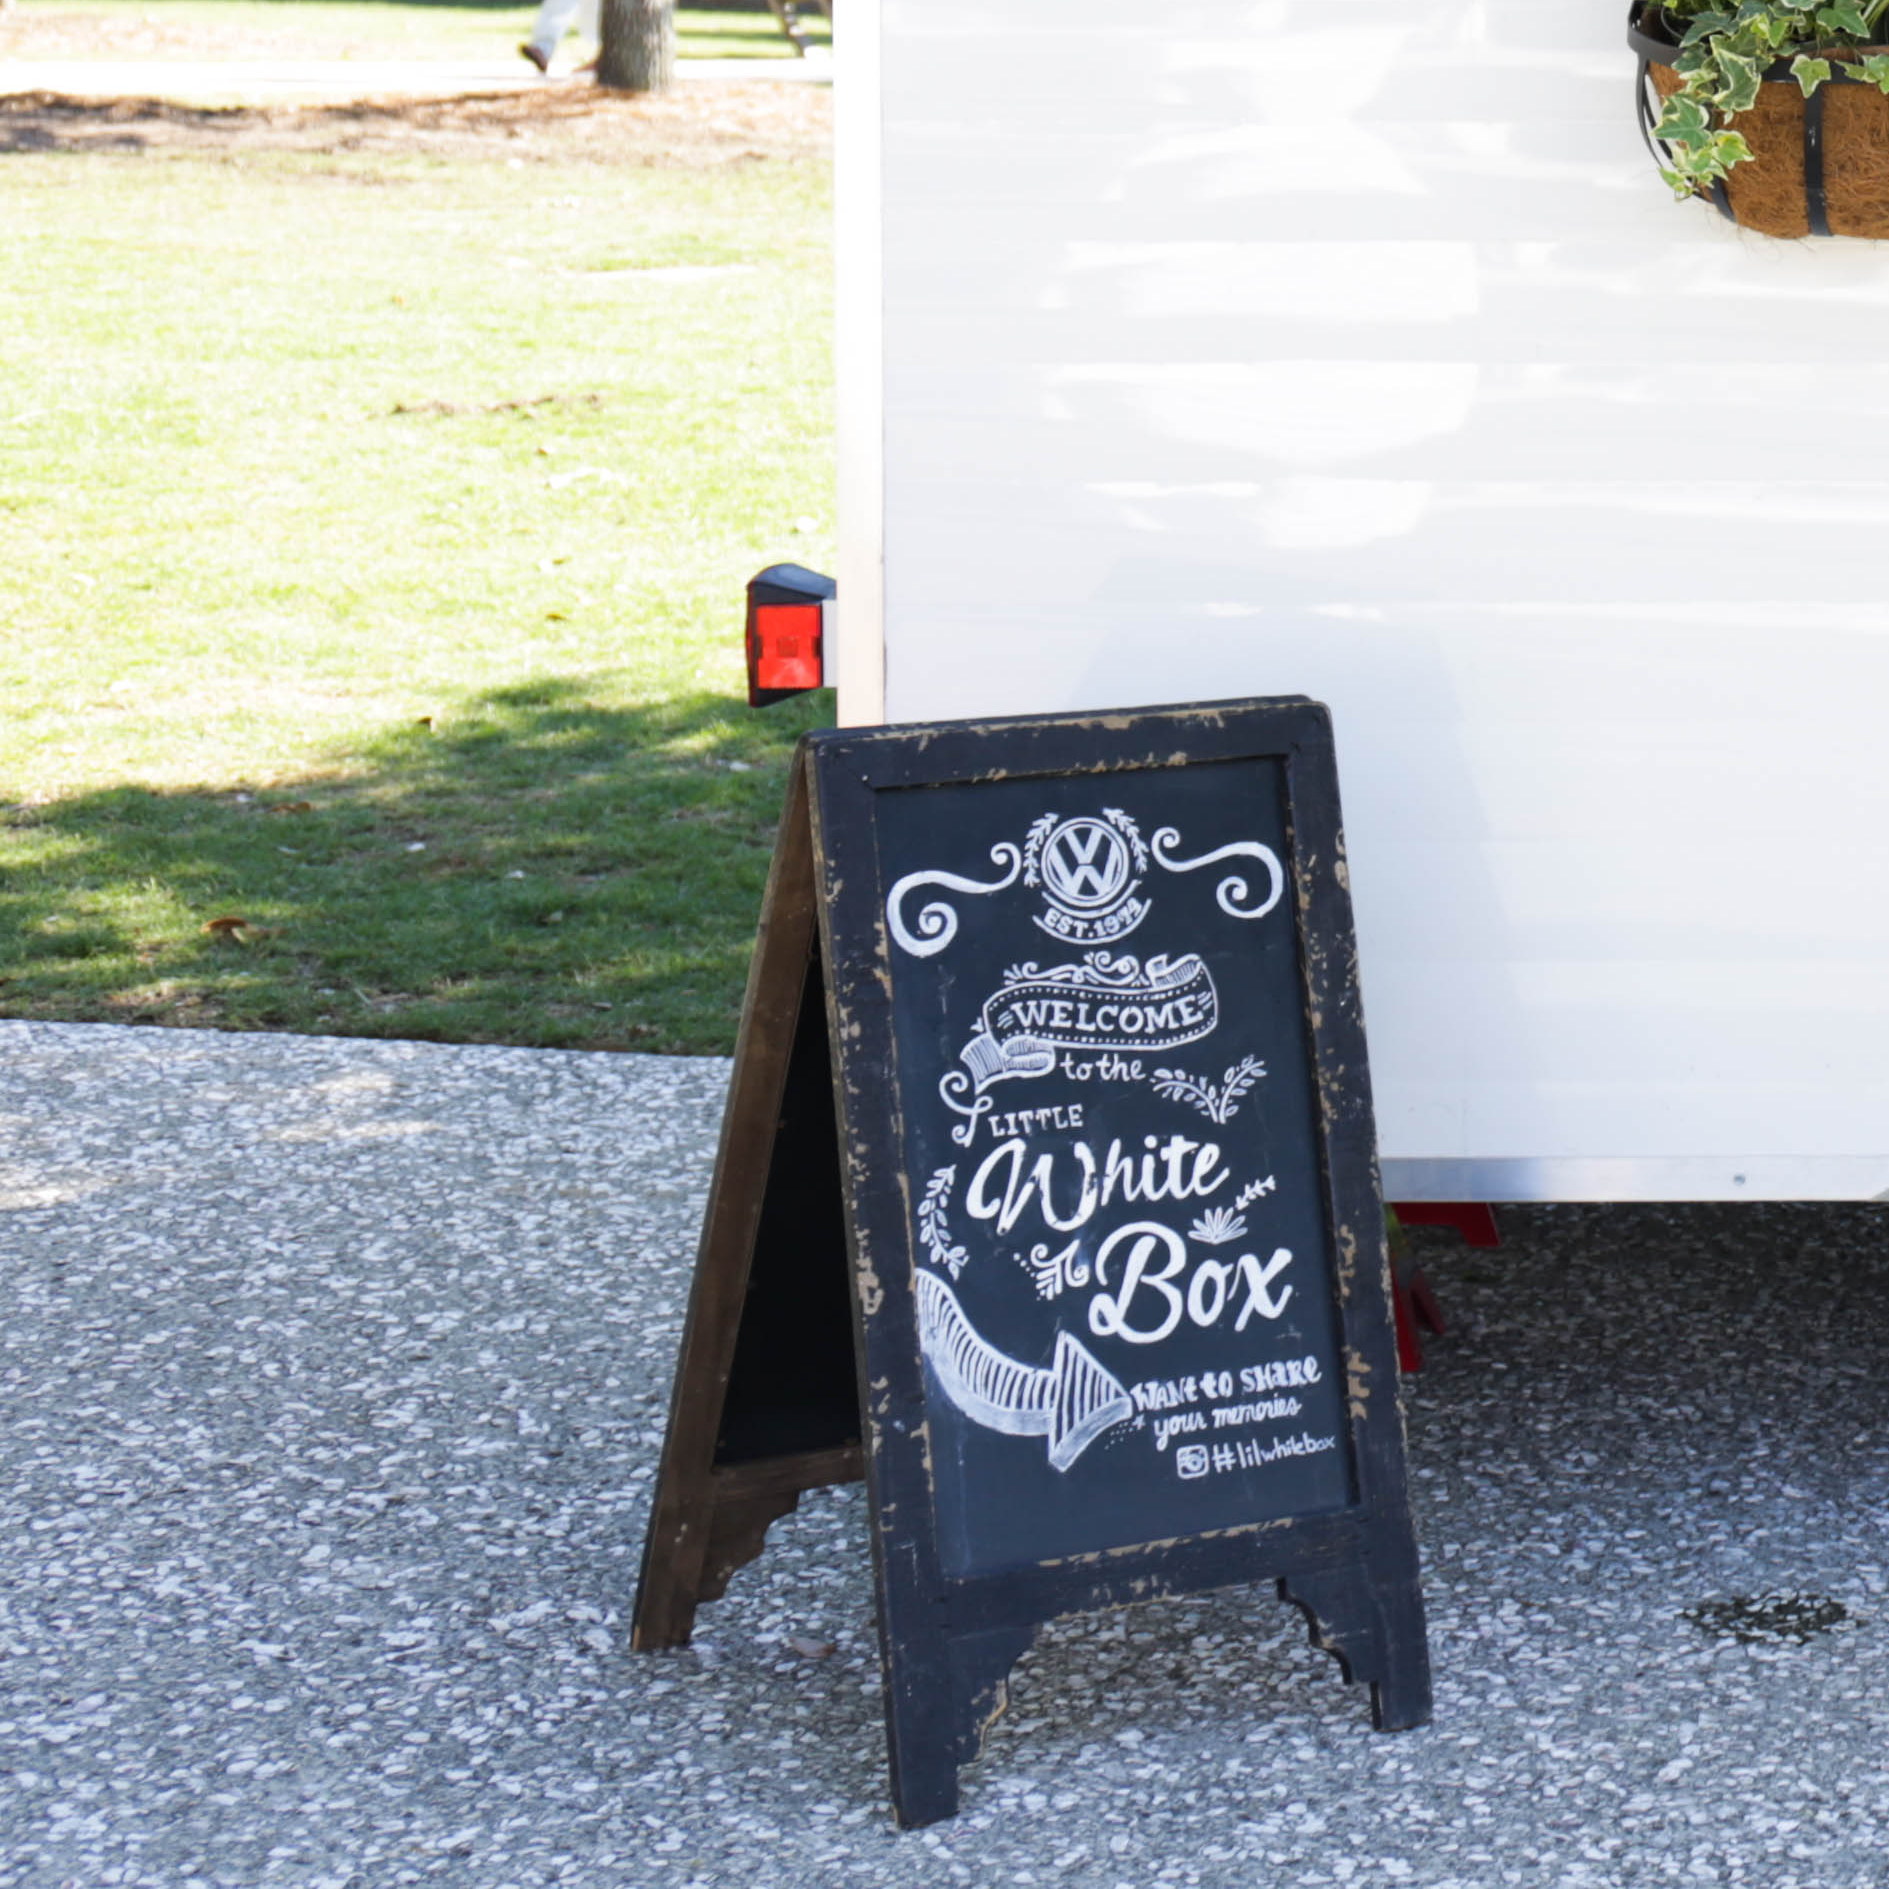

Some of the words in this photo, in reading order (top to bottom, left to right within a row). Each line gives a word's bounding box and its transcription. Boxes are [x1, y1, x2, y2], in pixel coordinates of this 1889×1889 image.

[1046, 823, 1123, 901] VW
[1010, 995, 1204, 1035] WELCOME
[1059, 1053, 1093, 1082] to
[1095, 1053, 1147, 1082] the
[987, 1103, 1083, 1138] LITTLE
[965, 1134, 1230, 1236] White
[1088, 1220, 1294, 1344] Box
[1199, 1370, 1233, 1399] to
[1153, 1411, 1208, 1452] your
[1211, 1392, 1303, 1429] memories
